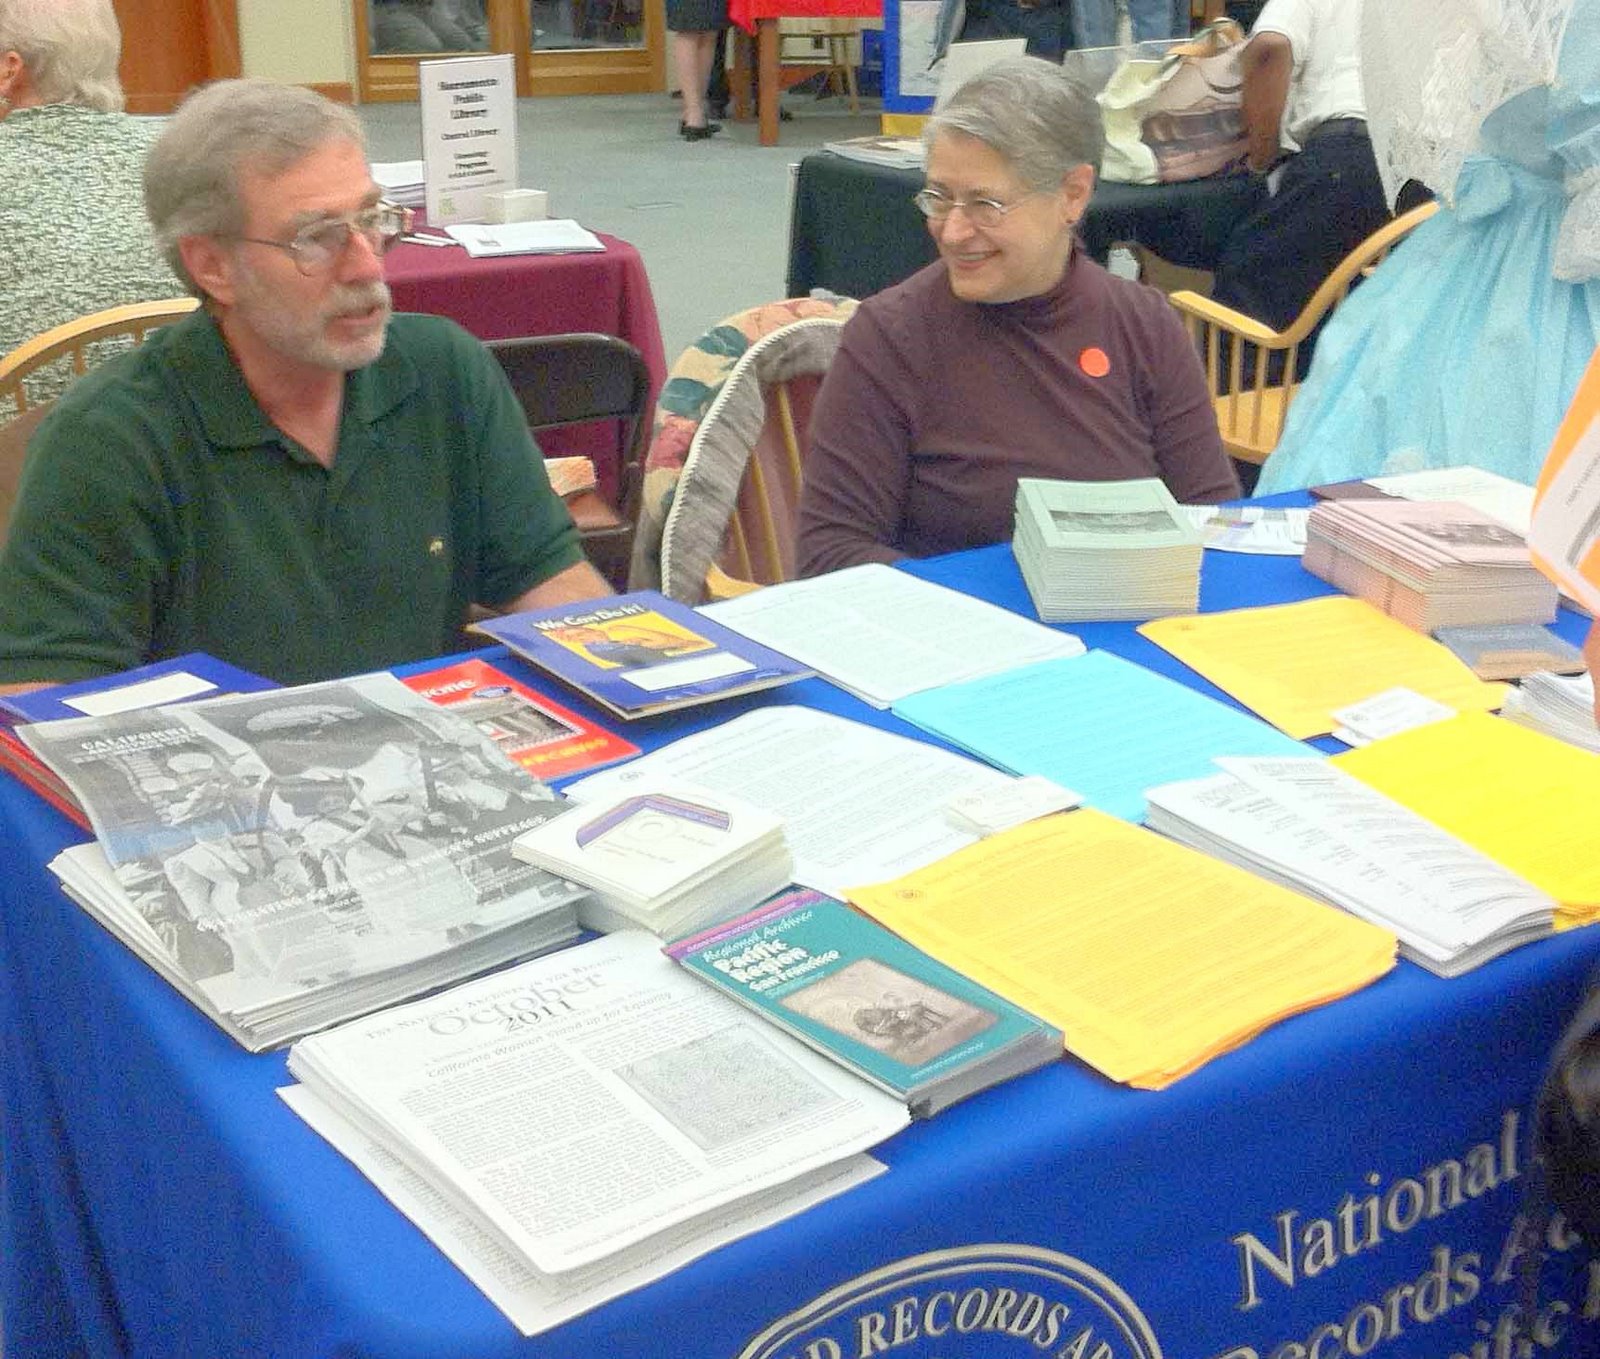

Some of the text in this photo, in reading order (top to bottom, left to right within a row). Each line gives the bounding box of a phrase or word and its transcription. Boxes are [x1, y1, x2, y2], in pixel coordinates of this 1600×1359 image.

[713, 939, 788, 973] Pacific
[729, 947, 809, 983] Region
[428, 971, 607, 1036] October
[504, 1000, 577, 1033] 2011
[1231, 1109, 1521, 1312] National
[859, 1288, 1070, 1358] RECORDS
